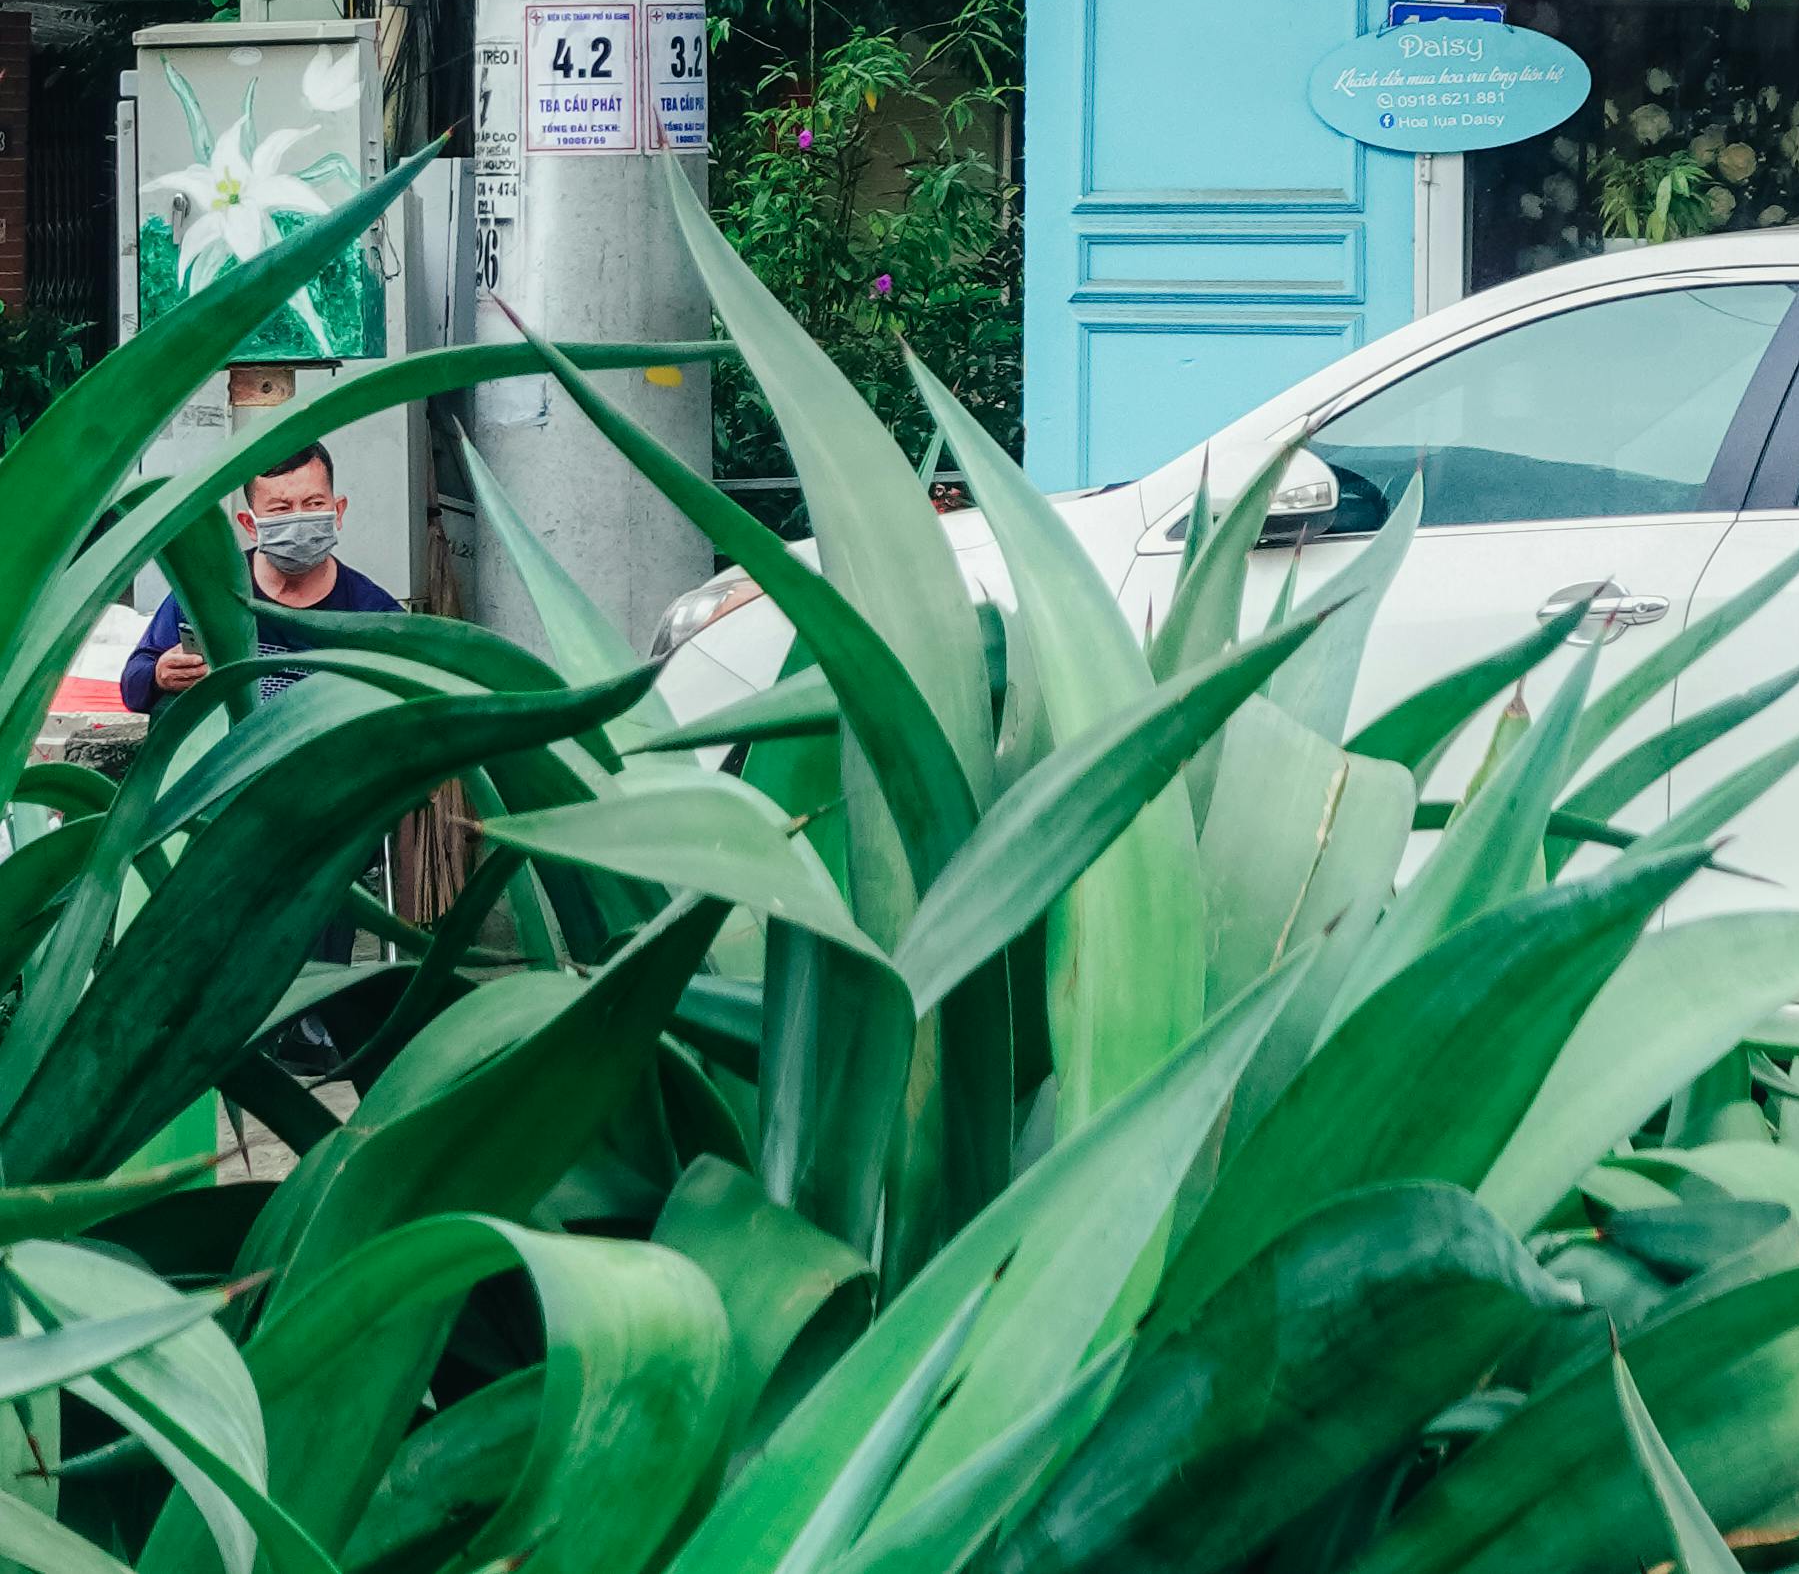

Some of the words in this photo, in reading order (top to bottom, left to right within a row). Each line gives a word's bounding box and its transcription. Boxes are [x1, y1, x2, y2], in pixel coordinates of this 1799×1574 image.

[552, 36, 613, 79] 4.2
[670, 35, 703, 78] 3.2
[1397, 33, 1484, 62] Daisy
[1406, 73, 1436, 86] mua
[1438, 65, 1464, 85] hoa
[540, 98, 560, 113] TBA
[591, 94, 623, 113] PHÁT
[1397, 91, 1505, 108] 0918.621.881
[1398, 115, 1429, 129] Hoa
[1461, 113, 1506, 129] Daisy
[492, 131, 517, 143] CAO
